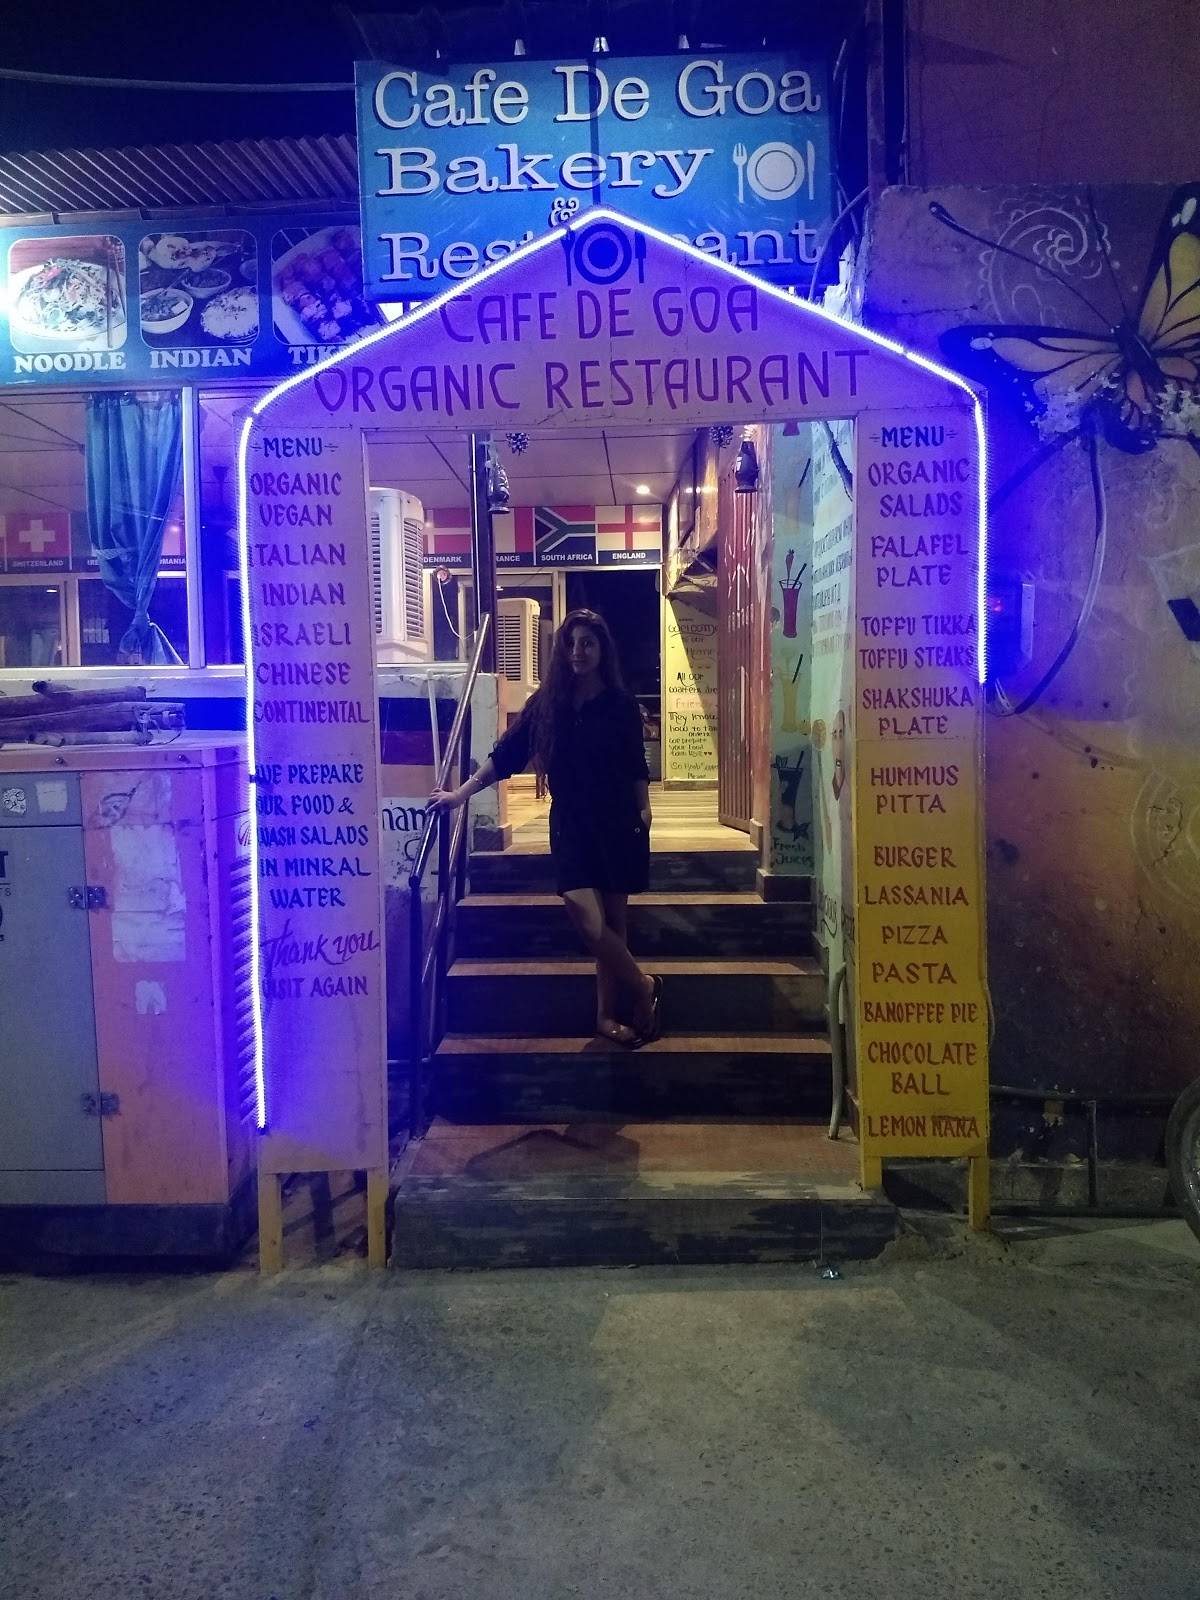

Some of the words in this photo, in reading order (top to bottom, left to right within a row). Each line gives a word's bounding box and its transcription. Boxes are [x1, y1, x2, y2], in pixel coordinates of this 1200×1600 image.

[375, 68, 530, 128] Cafe
[553, 64, 650, 123] De
[678, 60, 822, 118] Goa
[375, 143, 715, 198] Bakery
[440, 290, 557, 346] CAFE
[577, 288, 634, 340] DE
[652, 284, 759, 335] GOA
[13, 352, 127, 374] NOODLE
[150, 348, 253, 370] INDIAN
[313, 361, 520, 416] ORGANIC
[545, 349, 869, 411] RESTAURANT
[262, 437, 323, 459] MENU
[881, 426, 944, 448] MENU
[250, 472, 342, 496] ORGANIC
[868, 458, 971, 487] ORGANIC
[259, 504, 333, 527] VEGAN
[879, 491, 964, 518] SALADS
[541, 553, 566, 561] SOUTH
[567, 552, 593, 560] AFRICA
[612, 552, 646, 560] ENGLAND
[871, 534, 969, 558] FALAFEL
[876, 564, 952, 588] PLATE
[262, 582, 346, 606] INDIAN
[252, 622, 351, 647] ISRAELI
[861, 616, 916, 637] TOFFU
[921, 614, 976, 636] TIKKA
[859, 648, 909, 669] TOFFU
[914, 646, 975, 669] STEAKS
[256, 662, 351, 685] CHINESE
[862, 686, 975, 710] SHAKSHUKA
[254, 700, 371, 723] CONTINENTAL
[878, 715, 949, 736] PLATE
[288, 764, 364, 785] PREPARE
[871, 765, 959, 787] HUMMUS
[291, 794, 335, 815] FOOD
[338, 797, 354, 815] &
[876, 794, 947, 815] PITTA
[300, 825, 369, 846] SALADS
[260, 858, 279, 878] IN
[284, 857, 371, 878] MINRAL
[873, 845, 958, 869] BURGER
[269, 888, 346, 909] WATER
[864, 884, 970, 907] LASSANIA
[333, 930, 380, 962] you
[881, 925, 949, 945] PIZZA
[872, 961, 958, 985] PASTA
[310, 976, 369, 998] AGAIN
[864, 1001, 945, 1024] BANOFFEE
[951, 1001, 978, 1024] PIE
[867, 1041, 978, 1066] CHOCOLATE
[891, 1072, 951, 1096] BALL
[867, 1115, 927, 1138] LEMON
